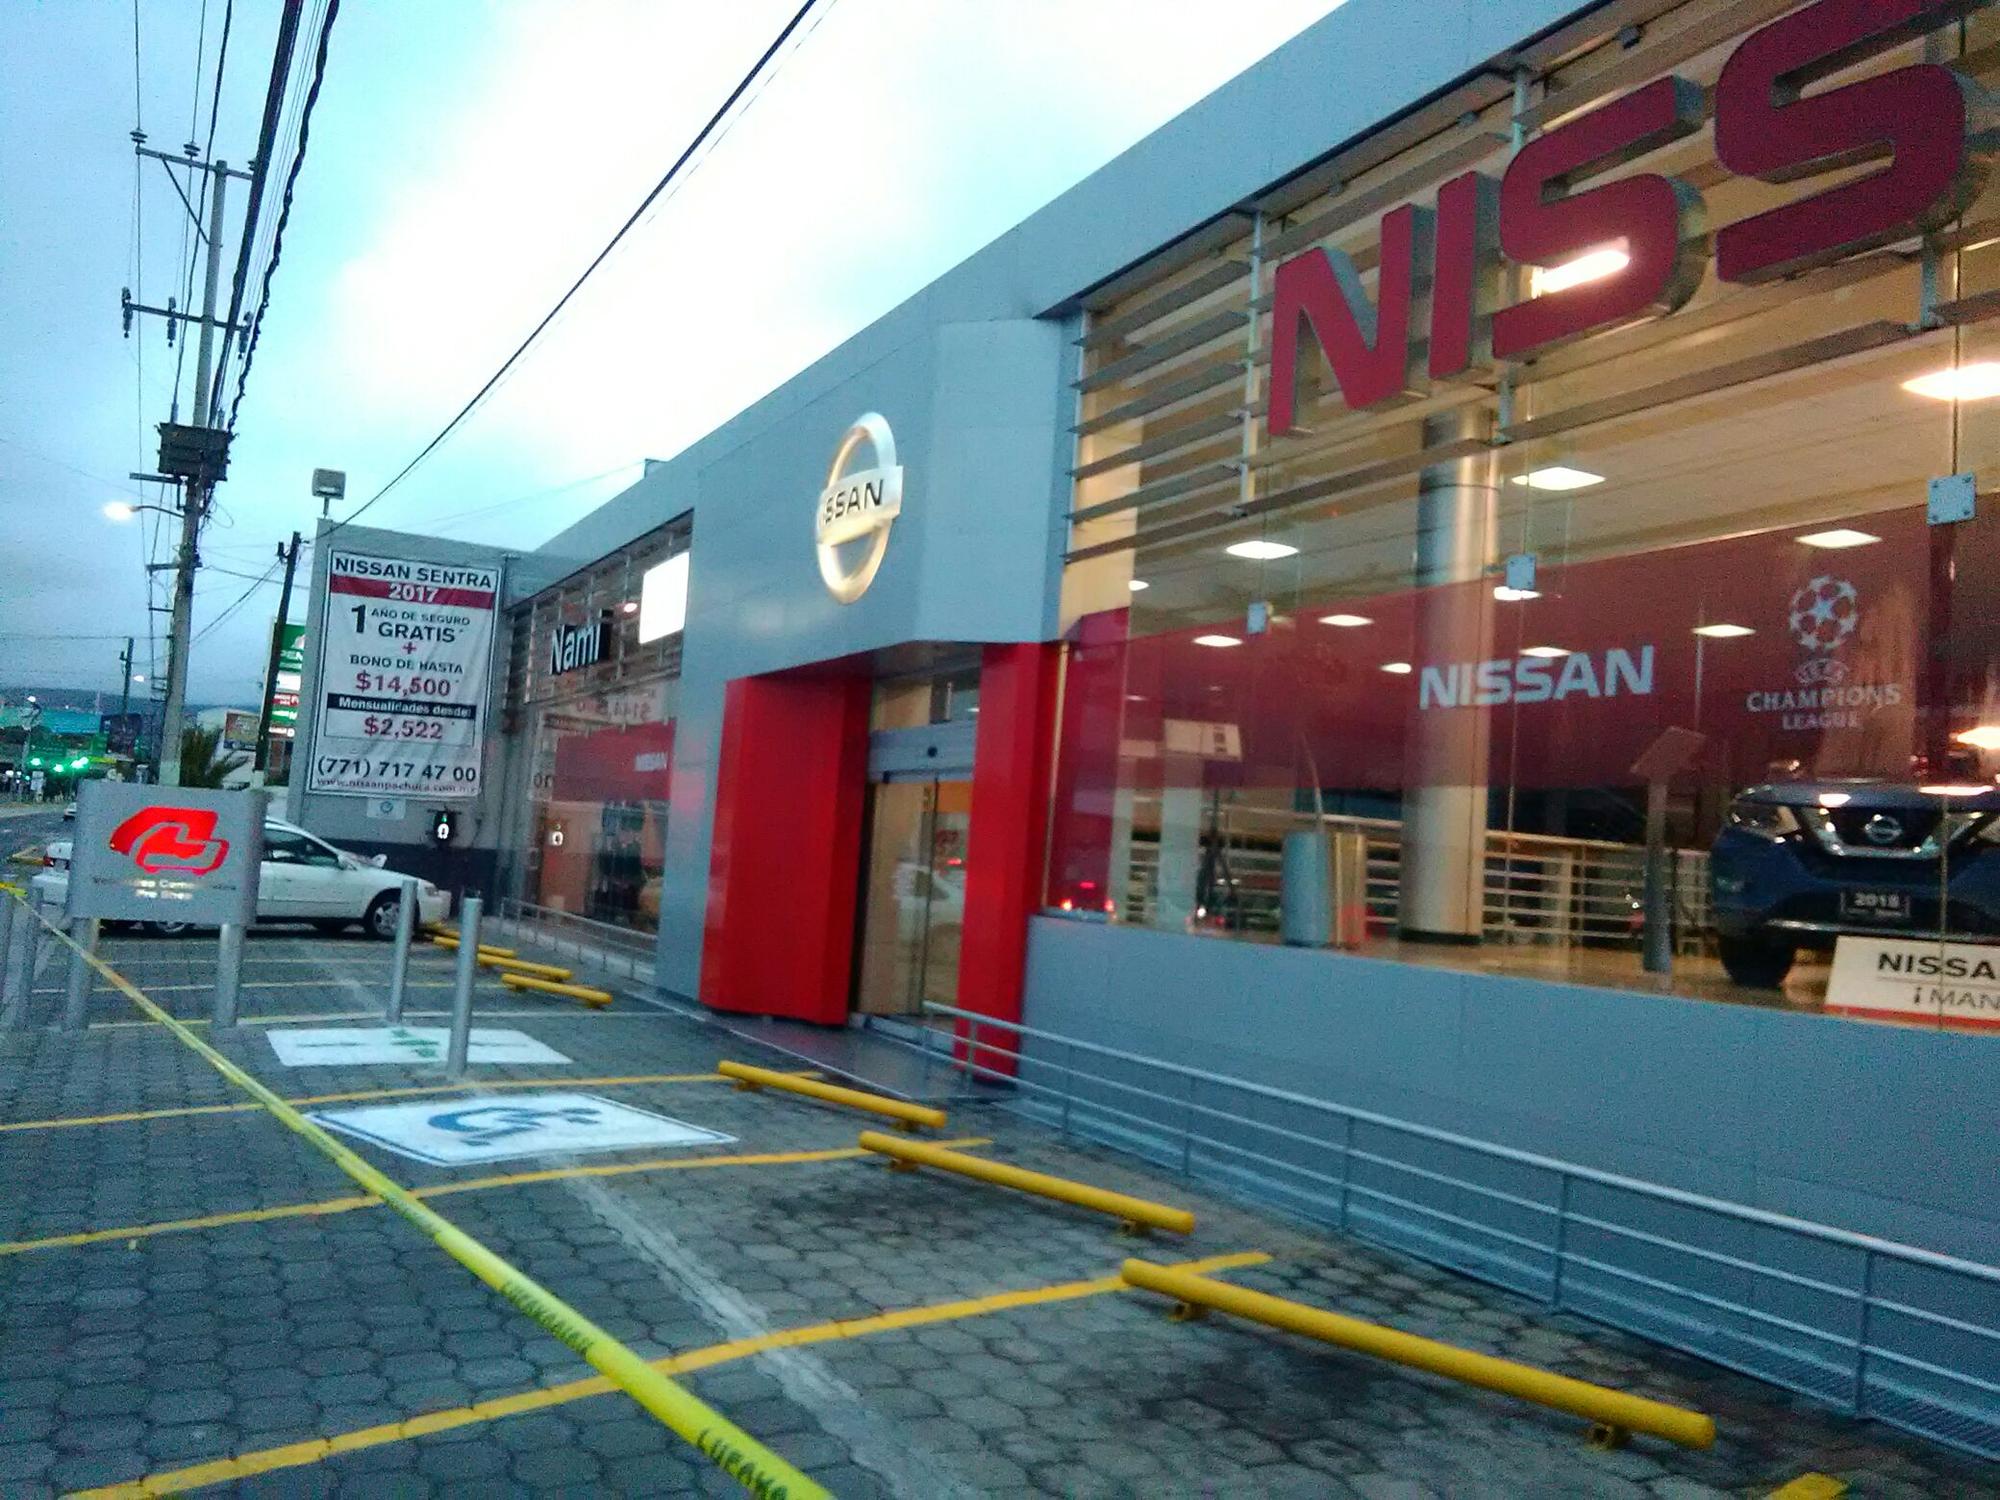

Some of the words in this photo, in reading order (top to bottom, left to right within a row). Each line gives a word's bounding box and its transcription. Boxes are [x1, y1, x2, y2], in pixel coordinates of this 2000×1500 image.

[335, 557, 411, 580] NISSAN
[417, 567, 492, 589] SENTRA
[388, 583, 440, 602] 2017
[352, 604, 367, 634] 1
[400, 610, 415, 622] DE
[421, 613, 471, 626] SEGURO
[378, 621, 456, 644] GRATIS
[350, 654, 392, 669] BONO
[396, 660, 414, 670] DE
[419, 662, 464, 675] HASTA
[1419, 645, 1655, 711] NISSAN
[356, 669, 450, 697] $14,500
[338, 697, 430, 714] Mensualidades
[1745, 683, 1902, 712] CHAMPIONS
[363, 715, 443, 740] $2,522
[317, 755, 371, 778] (771)
[379, 761, 415, 778] 717
[422, 764, 447, 780] 47
[453, 766, 477, 782] 00
[1877, 952, 1997, 981] NISSA
